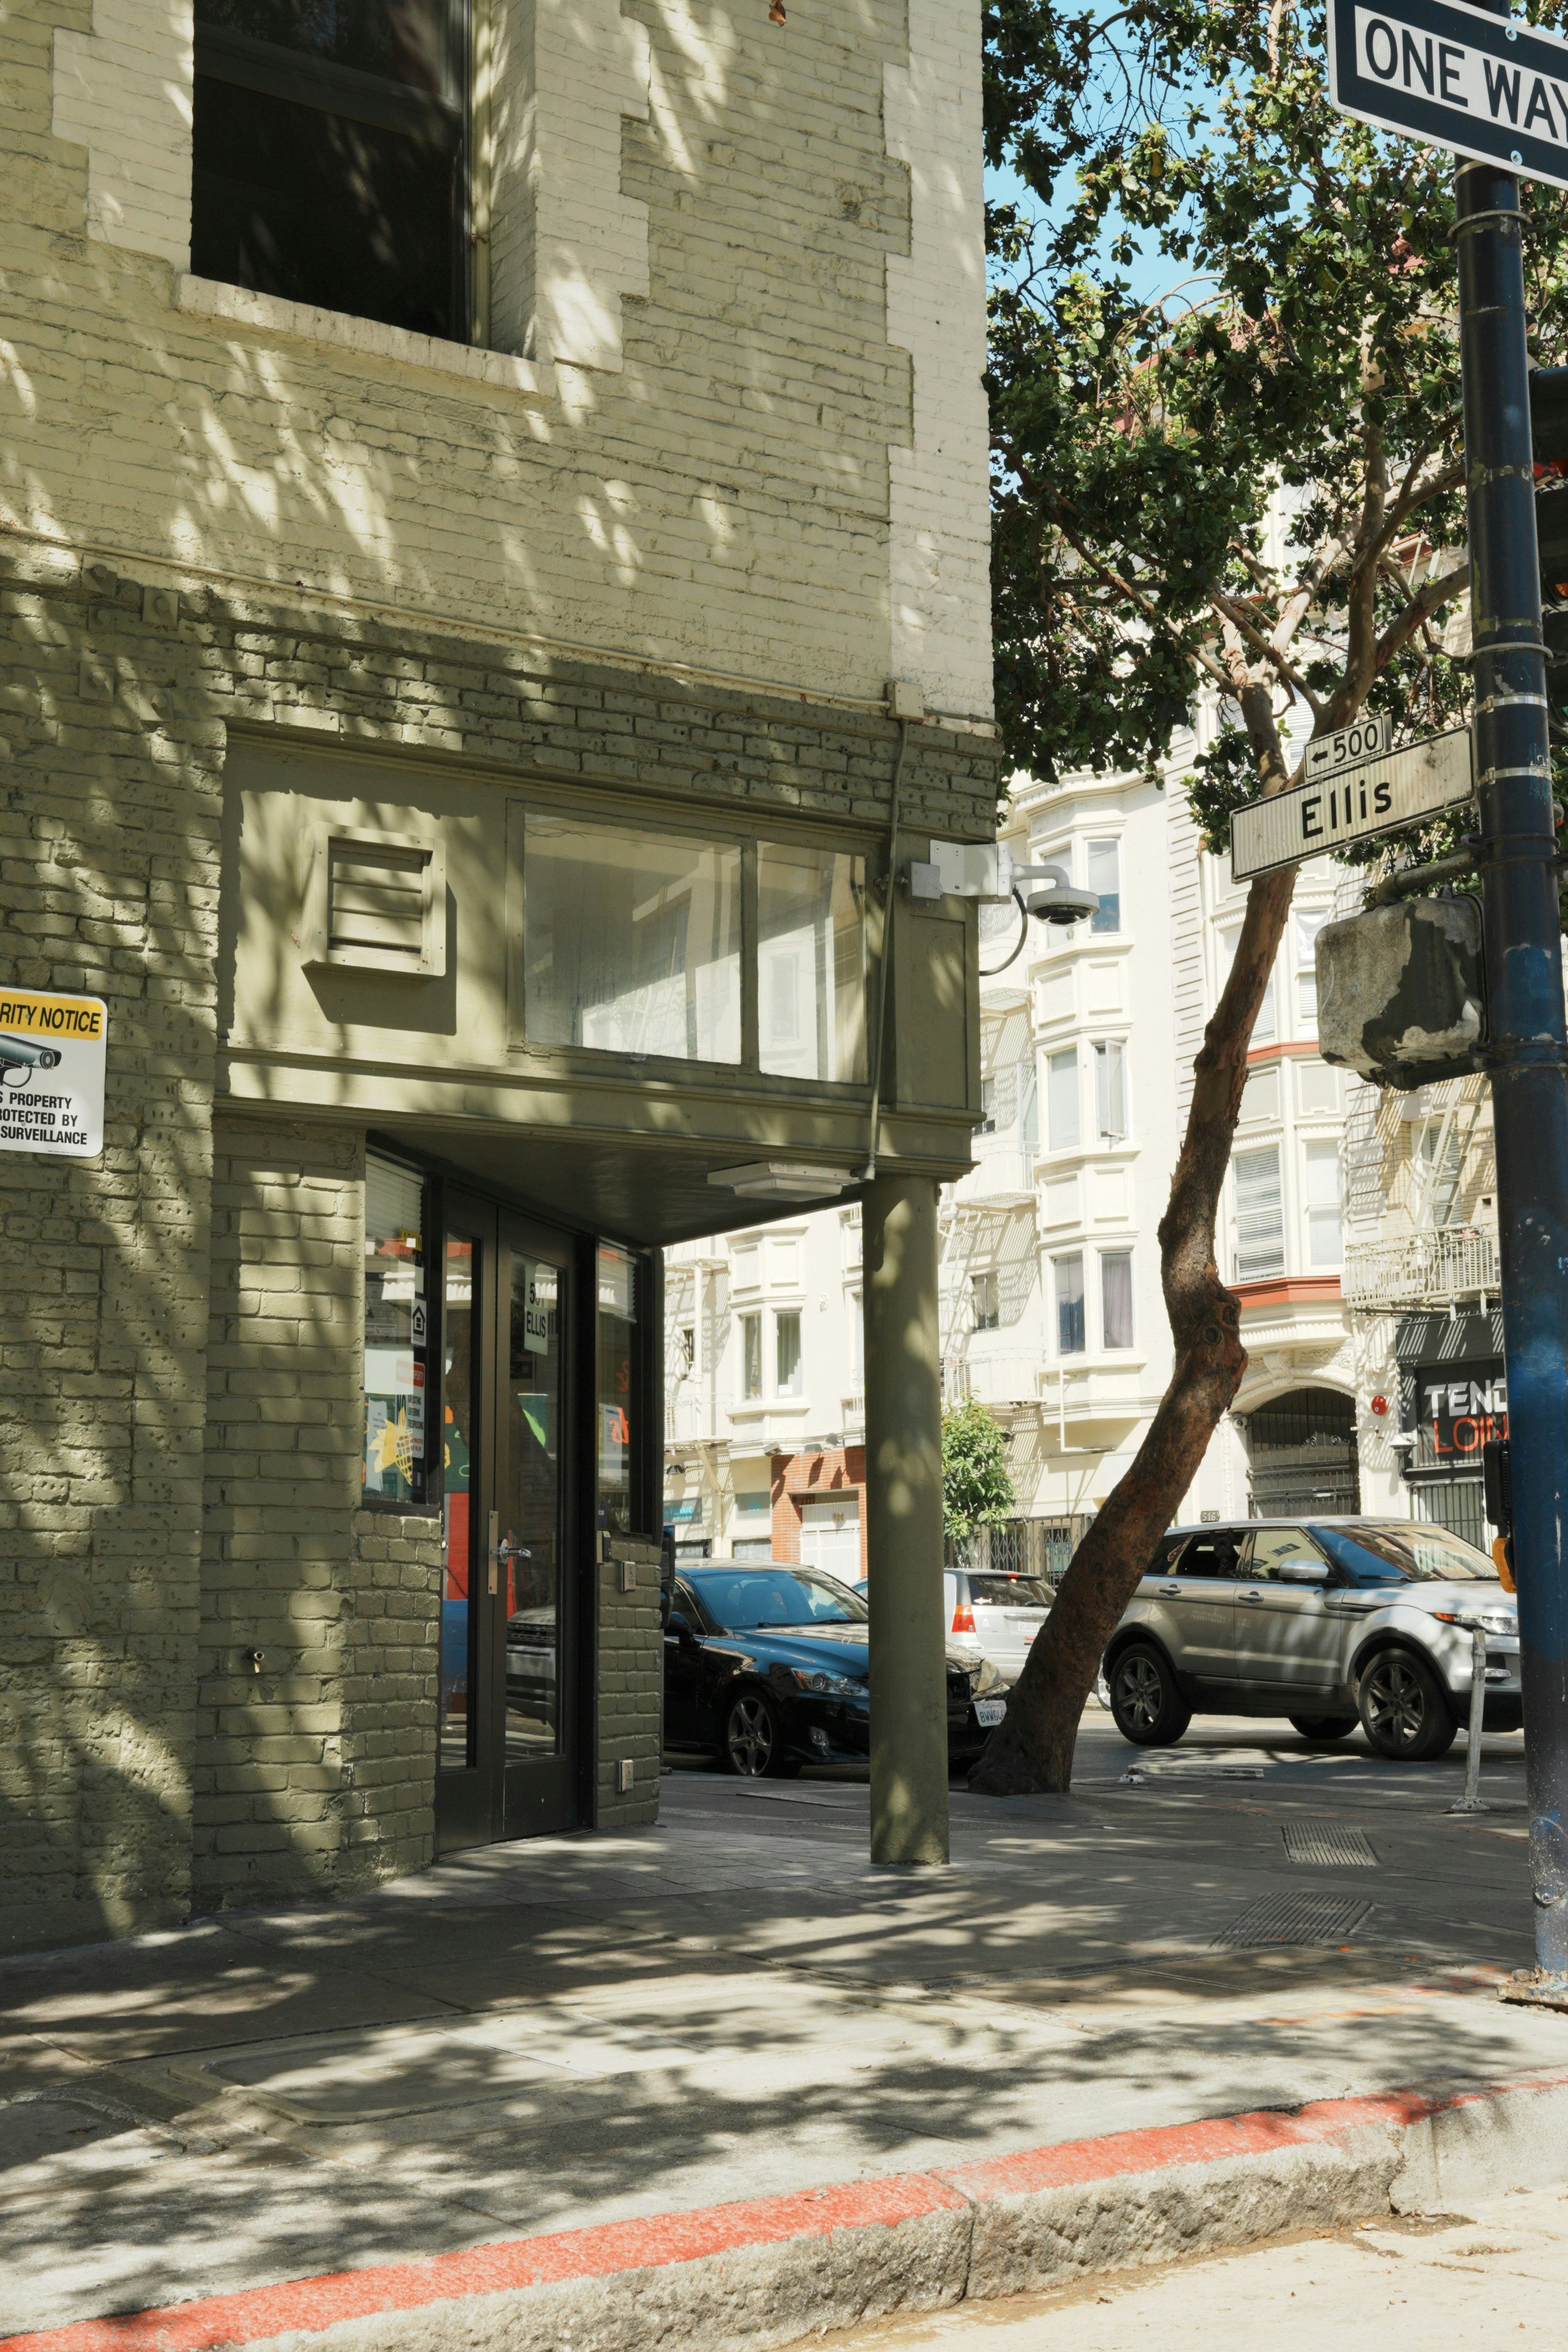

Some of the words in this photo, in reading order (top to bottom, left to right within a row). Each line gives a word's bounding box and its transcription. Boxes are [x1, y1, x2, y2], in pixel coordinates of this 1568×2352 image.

[1366, 19, 1468, 107] ONE
[1334, 723, 1378, 764] 500
[1301, 779, 1392, 839] Ellis
[39, 1007, 101, 1033] NOTICE
[10, 1092, 72, 1109] PROPERTY
[0, 1108, 56, 1125] OTECTED
[62, 1115, 78, 1127] BY
[0, 1125, 87, 1145] SURVEILLANCE
[527, 1311, 546, 1338] ELLIS
[407, 1419, 424, 1430] TRESPASSING
[1202, 1512, 1215, 1521] 516
[980, 1709, 1006, 1723] 8WWG46
